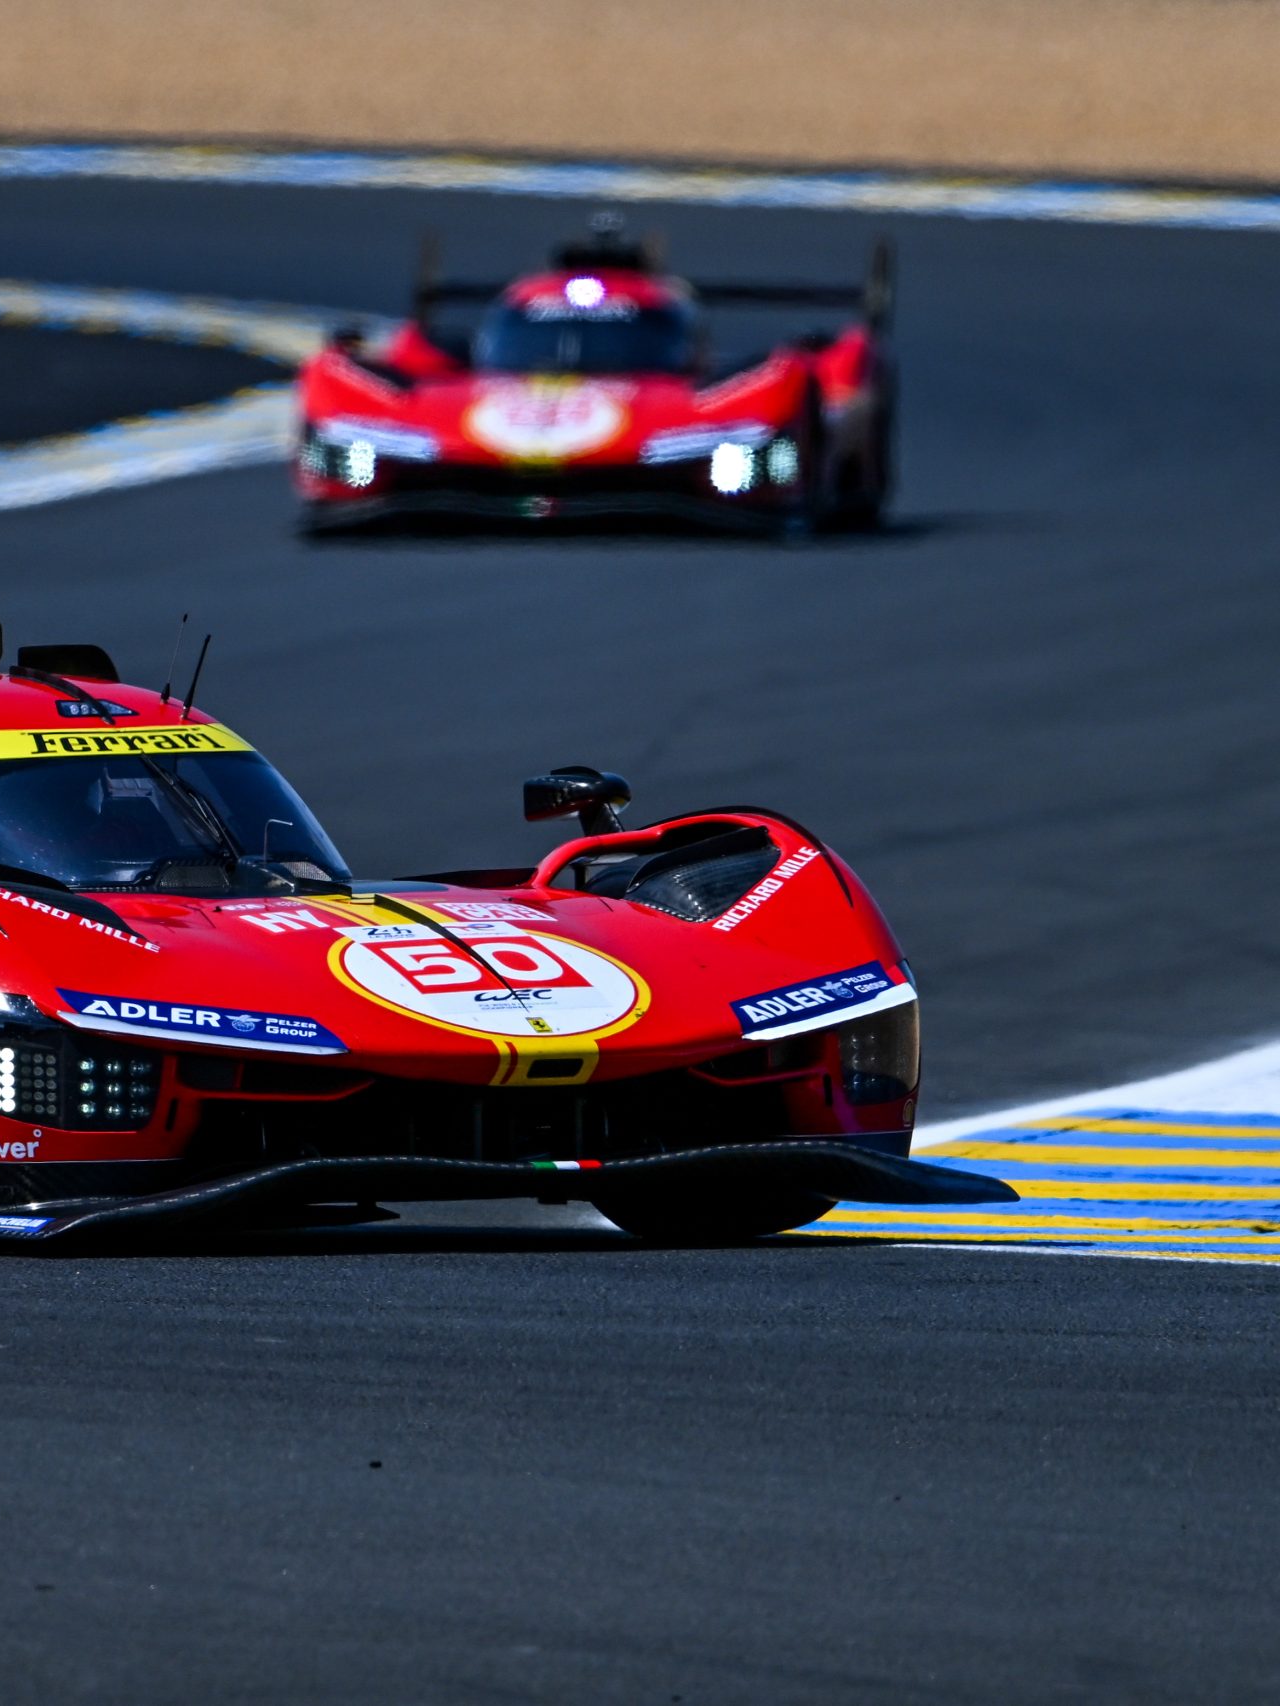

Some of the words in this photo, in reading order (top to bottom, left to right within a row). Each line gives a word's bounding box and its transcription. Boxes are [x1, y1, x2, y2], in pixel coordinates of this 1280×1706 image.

[29, 727, 225, 755] Ferrari
[711, 876, 784, 932] RICHARD
[773, 845, 821, 880] MILLE
[78, 917, 161, 953] MILLE
[238, 909, 331, 933] HY
[381, 942, 564, 986] 50
[840, 973, 878, 986] PELZER
[80, 998, 221, 1028] ADLER
[265, 1017, 318, 1030] PELZER
[739, 986, 836, 1024] ADLER
[854, 980, 889, 994] GROUP
[265, 1025, 318, 1038] GROUP
